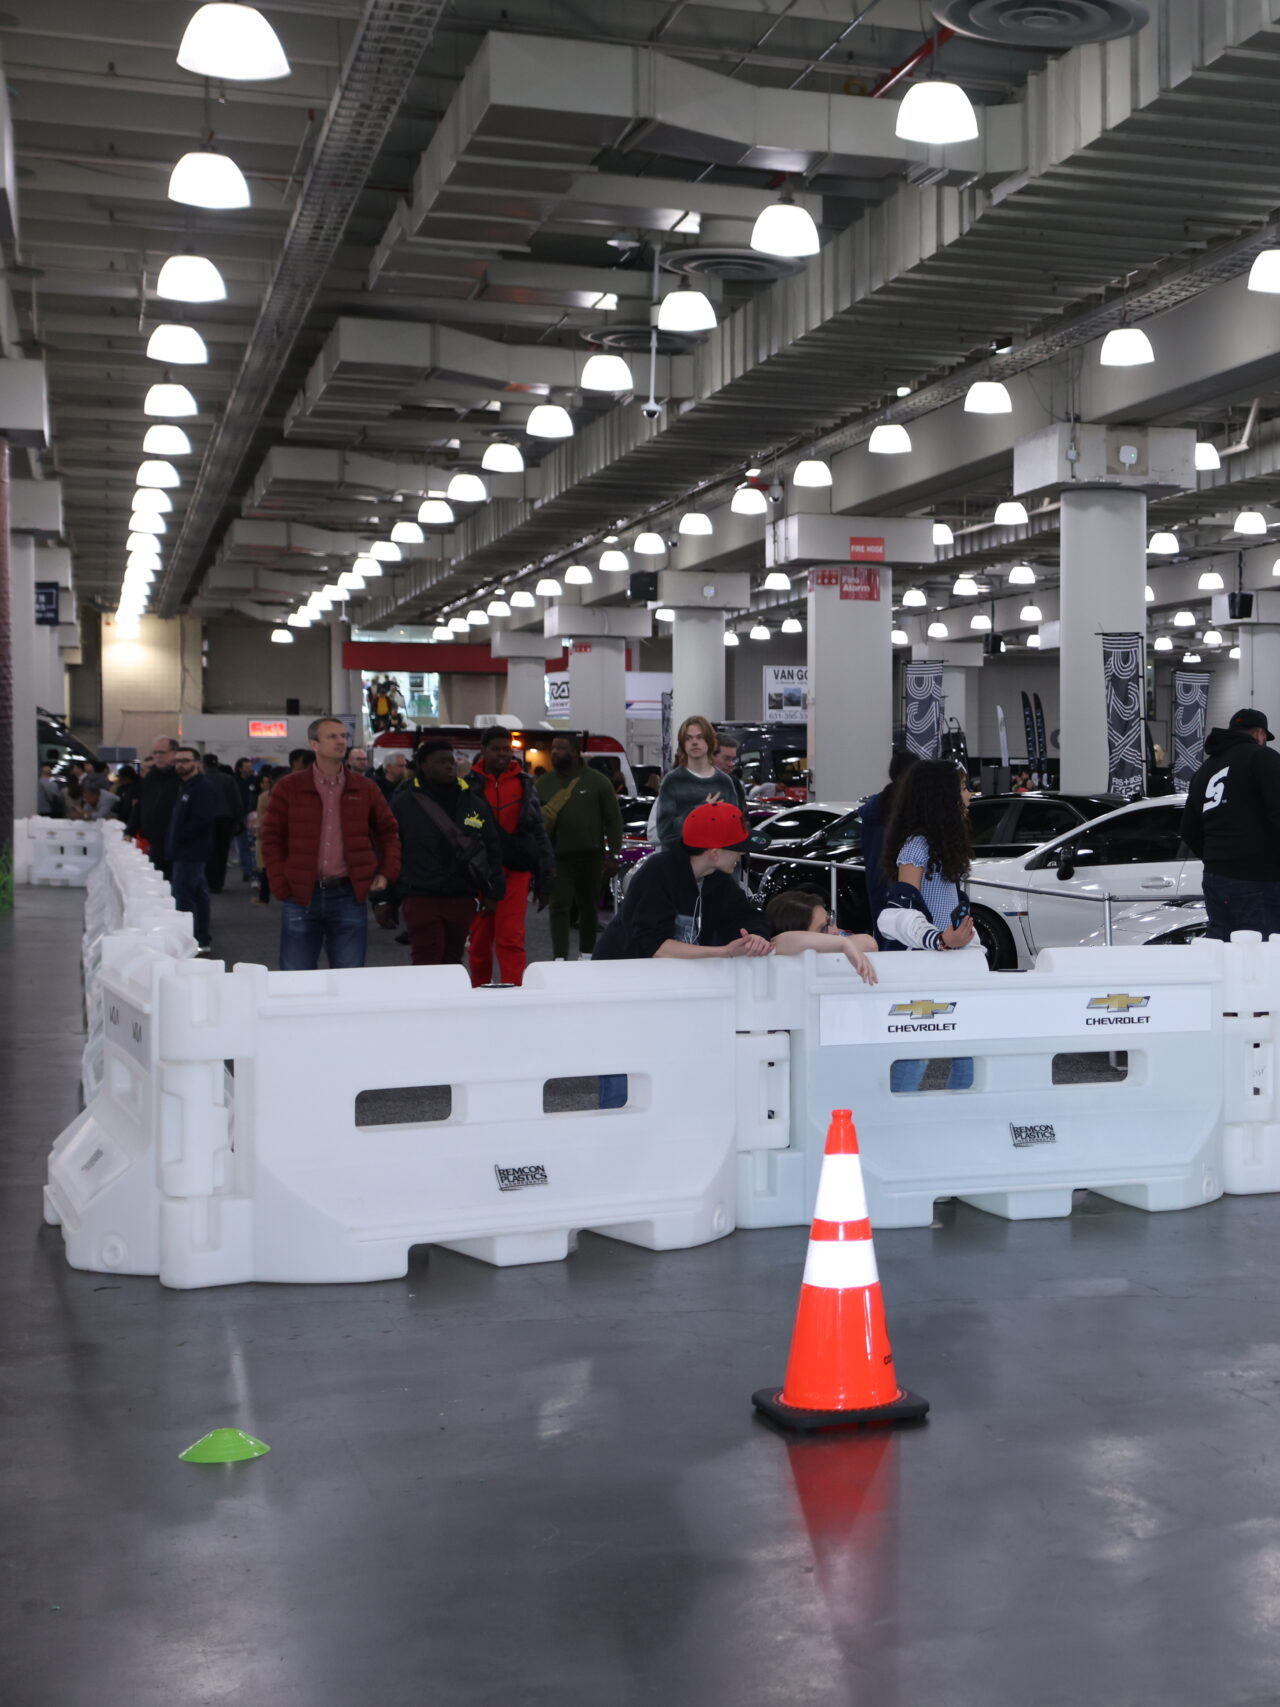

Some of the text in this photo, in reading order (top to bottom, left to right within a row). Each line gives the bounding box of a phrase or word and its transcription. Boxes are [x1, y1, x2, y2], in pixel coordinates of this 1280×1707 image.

[851, 544, 865, 553] FIRE
[842, 584, 871, 592] Alarm
[773, 669, 794, 680] VAN
[251, 721, 285, 736] Exit
[1085, 1015, 1151, 1026] CHEVROLET
[887, 1022, 957, 1033] CHEVROLET
[1012, 1124, 1054, 1134] REMCON
[1015, 1131, 1056, 1140] PLASTICS
[498, 1164, 546, 1177] REMCON
[500, 1173, 548, 1183] PLASTICS
